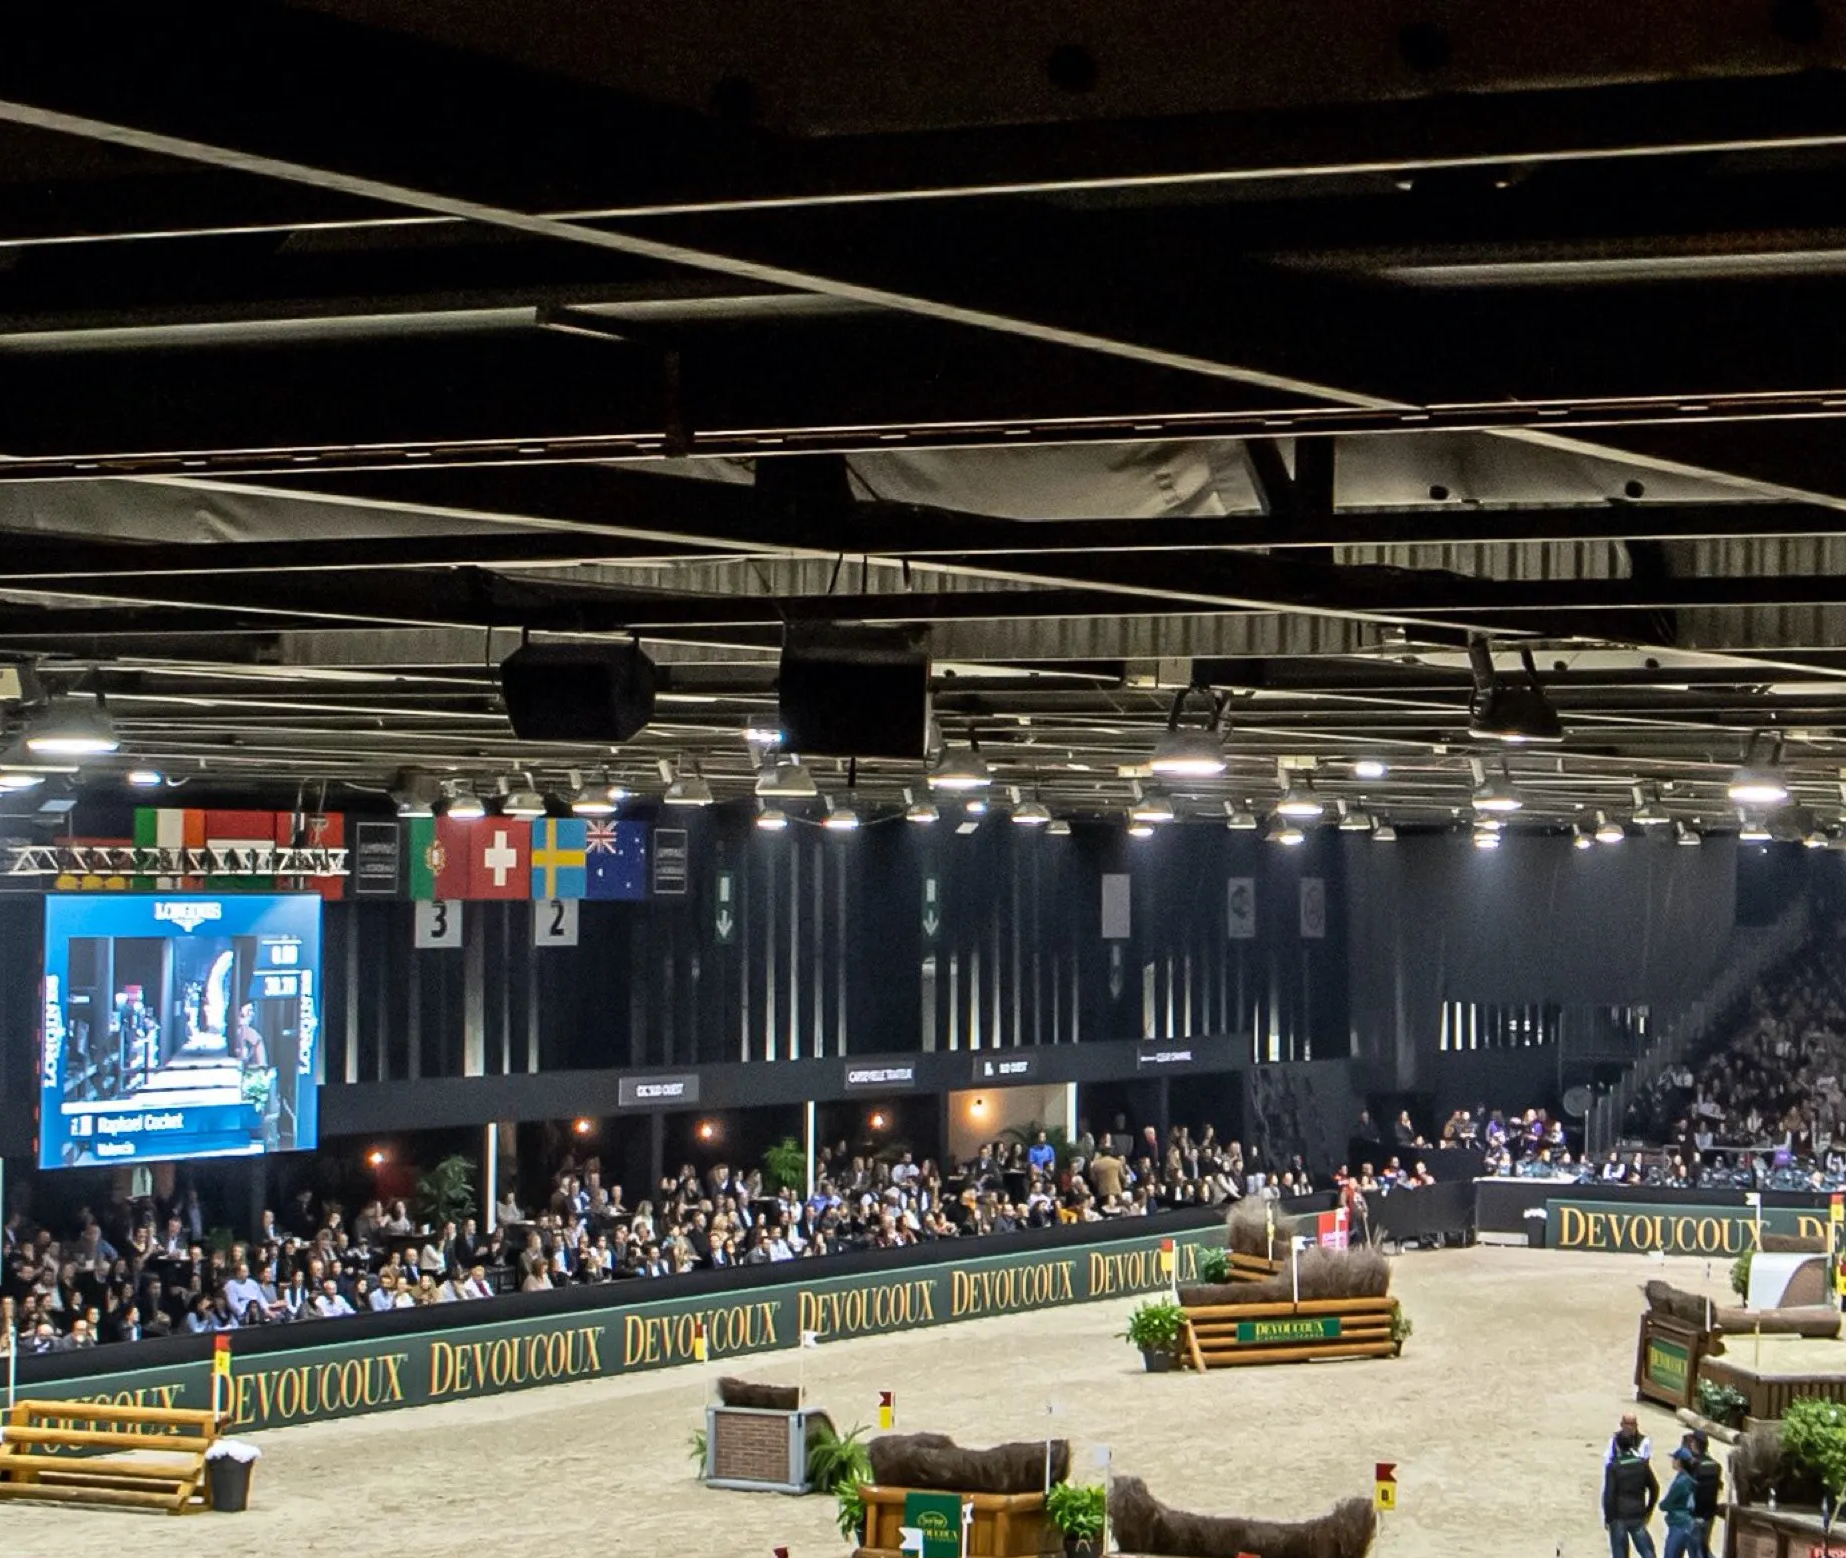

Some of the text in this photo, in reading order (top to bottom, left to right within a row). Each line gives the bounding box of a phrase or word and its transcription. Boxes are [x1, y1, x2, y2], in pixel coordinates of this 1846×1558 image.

[431, 903, 448, 938] 3
[549, 901, 565, 937] 2
[1559, 1207, 1766, 1253] DEVOUCOUX
[799, 1279, 936, 1336] DEVOUCOUX
[952, 1260, 1075, 1316] DEVOUCOUX
[210, 1353, 407, 1425] DEVOUCOUX
[428, 1326, 604, 1396] DEVOUCOUX
